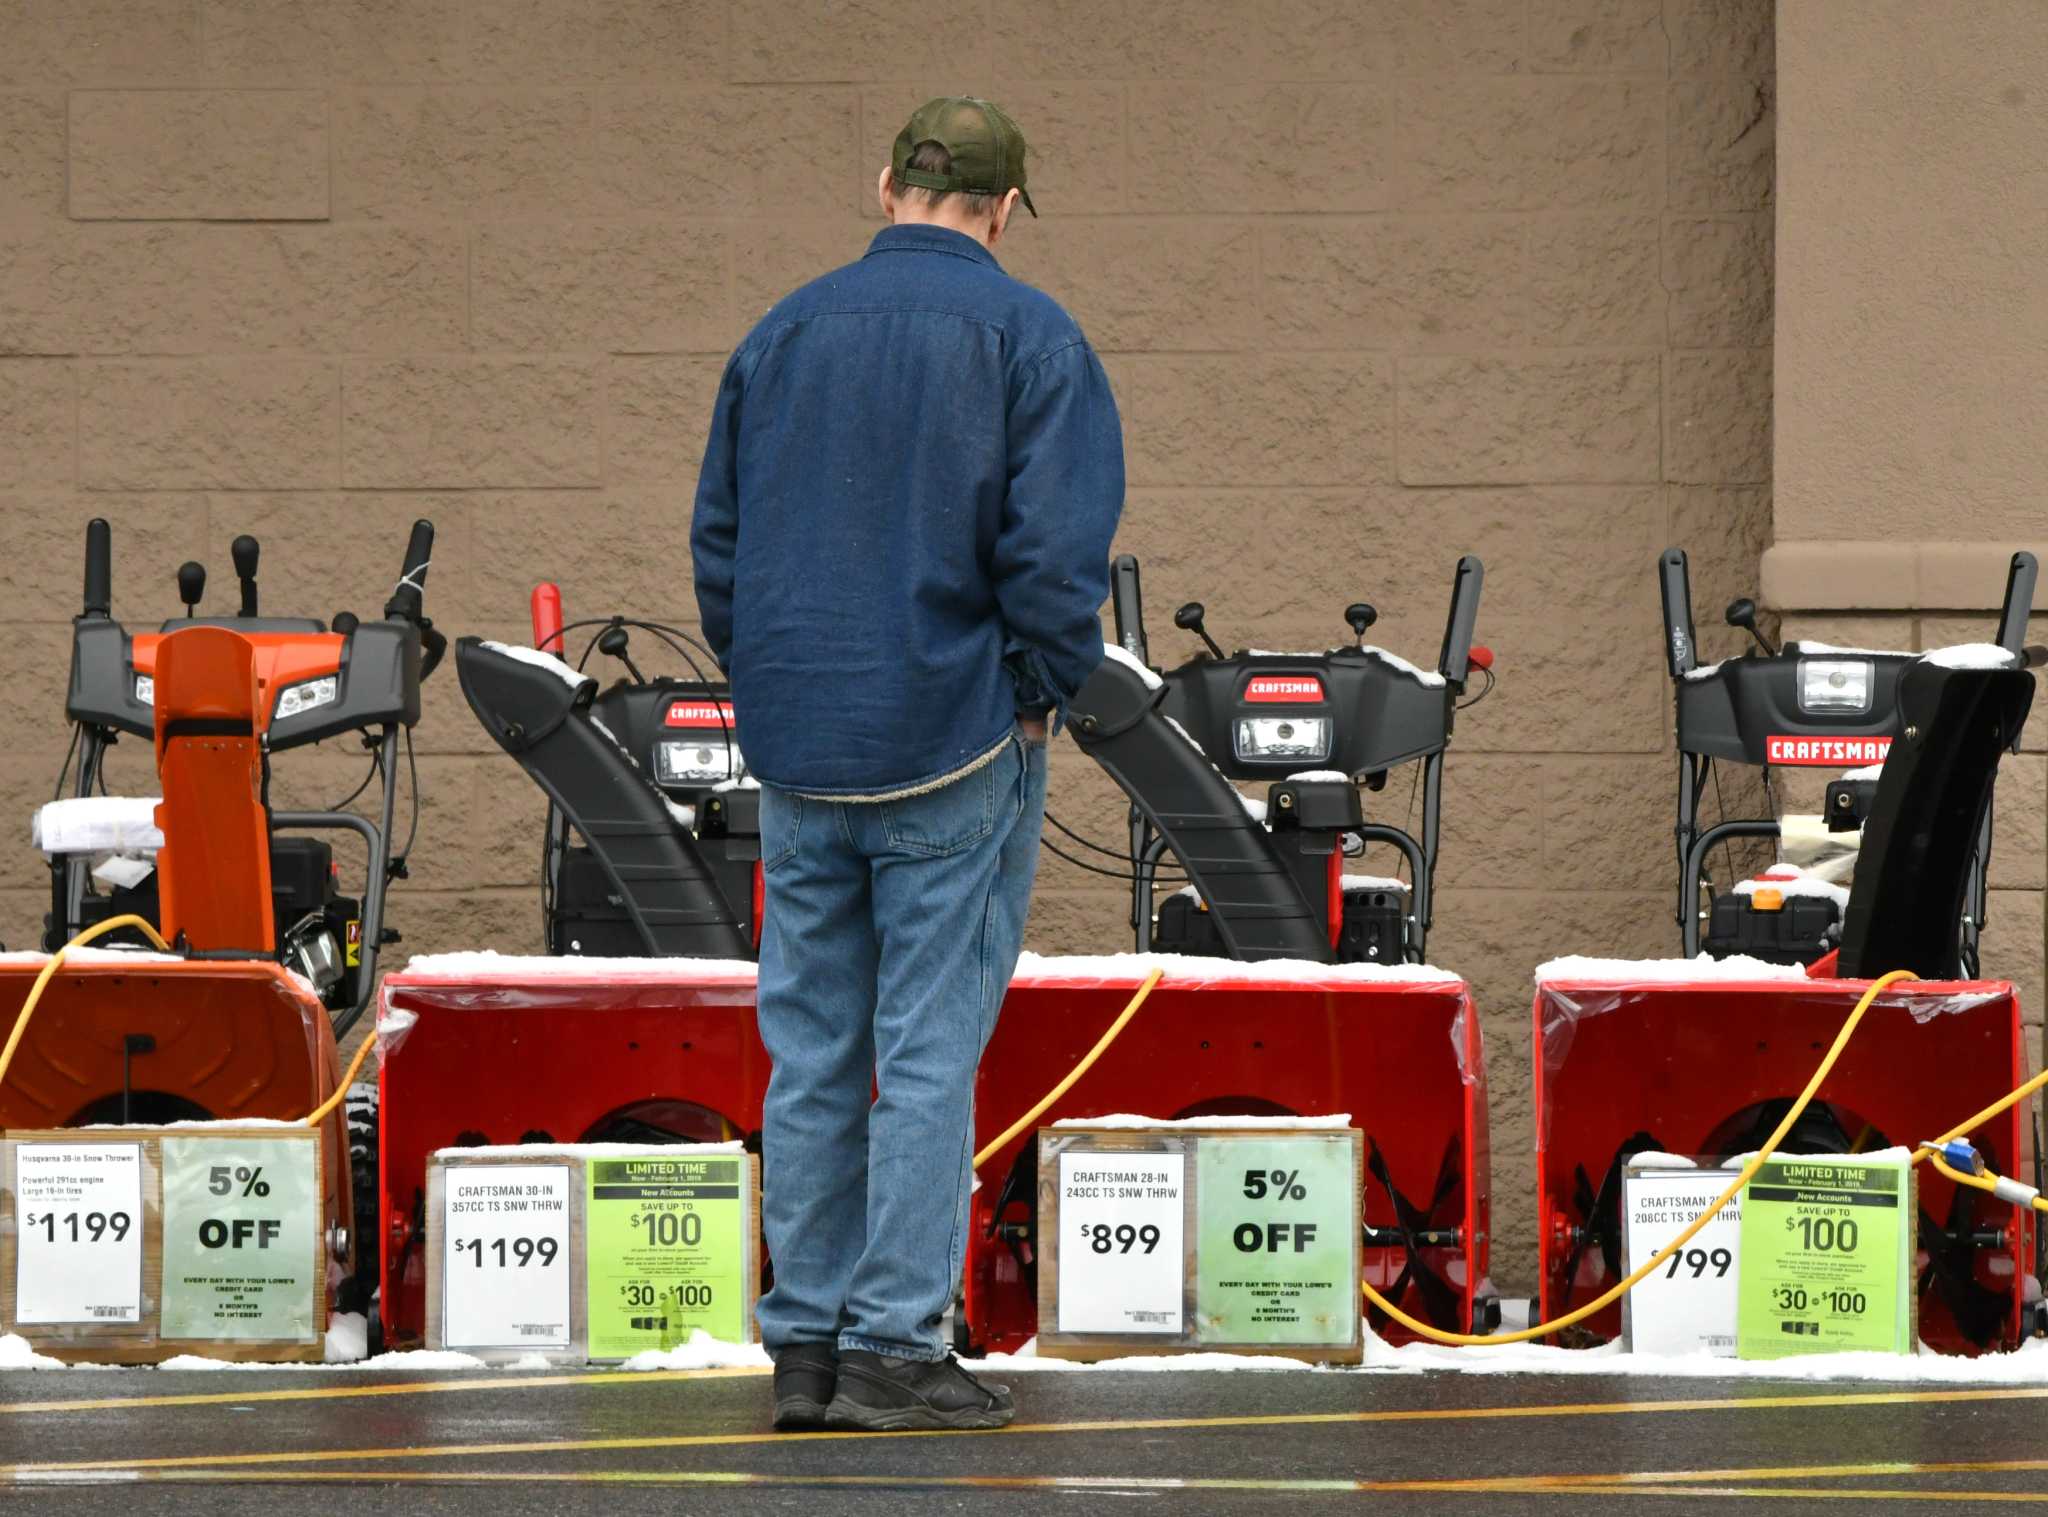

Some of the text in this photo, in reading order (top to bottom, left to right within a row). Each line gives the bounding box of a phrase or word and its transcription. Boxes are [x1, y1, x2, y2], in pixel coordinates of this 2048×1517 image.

[1251, 683, 1318, 693] CRAFTSMAN
[1771, 742, 1892, 759] CRAFTSMAN
[22, 1154, 60, 1163] Husqvarna
[83, 1154, 103, 1162] Snow
[105, 1154, 134, 1162] Thrower
[625, 1163, 707, 1174] LIMITED TIME
[1782, 1166, 1866, 1180] LIMITED TIME
[22, 1176, 104, 1185] Powerful 291cc engine
[208, 1166, 271, 1198] 5%
[1073, 1171, 1168, 1183] CRAFTSMAN 28-IN
[1808, 1179, 1837, 1188] February
[22, 1187, 43, 1196] Large
[66, 1187, 83, 1195] tires
[458, 1185, 553, 1197] CRAFTSMAN 30-IN
[1243, 1169, 1307, 1201] 5%
[1066, 1187, 1178, 1199] 243CC TS SNW THRW
[1798, 1192, 1852, 1202] New Accounts
[452, 1200, 563, 1213] 357CC TS SNW THRW
[641, 1202, 693, 1211] SAVE UP TO
[1640, 1196, 1706, 1208] CRAFTSMAN
[1634, 1212, 1668, 1224] 208CC
[1671, 1211, 1684, 1222] TS
[1687, 1211, 1707, 1222] SN
[1797, 1207, 1850, 1216] SAVE UP TO
[27, 1211, 131, 1243] $1199
[198, 1218, 281, 1249] OFF
[631, 1213, 701, 1246] $100
[1080, 1224, 1160, 1254] $899
[1233, 1222, 1317, 1253] OFF
[1786, 1216, 1858, 1252] $100
[455, 1237, 559, 1268] $1199
[620, 1285, 655, 1306] $30
[668, 1285, 712, 1306] $100
[1772, 1288, 1807, 1310] $30
[1822, 1291, 1866, 1314] $100
